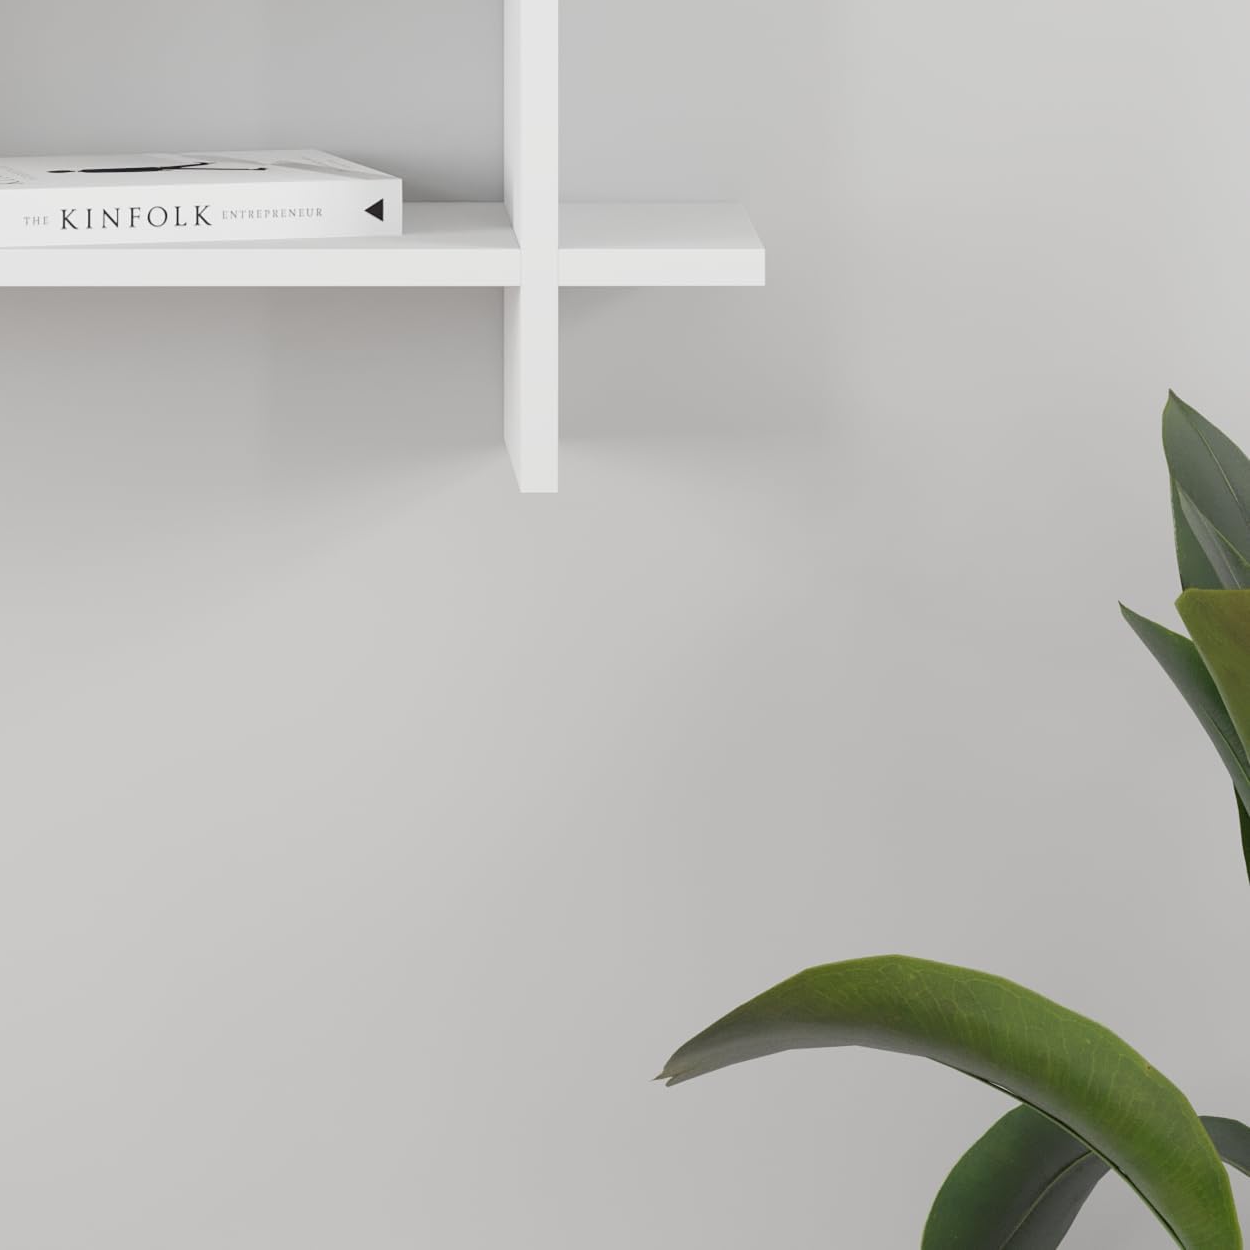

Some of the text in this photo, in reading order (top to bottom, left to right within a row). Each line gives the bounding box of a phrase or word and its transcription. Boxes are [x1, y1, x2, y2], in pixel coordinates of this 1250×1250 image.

[22, 205, 324, 231] THE KINFOLK ENTREPRENEUR
